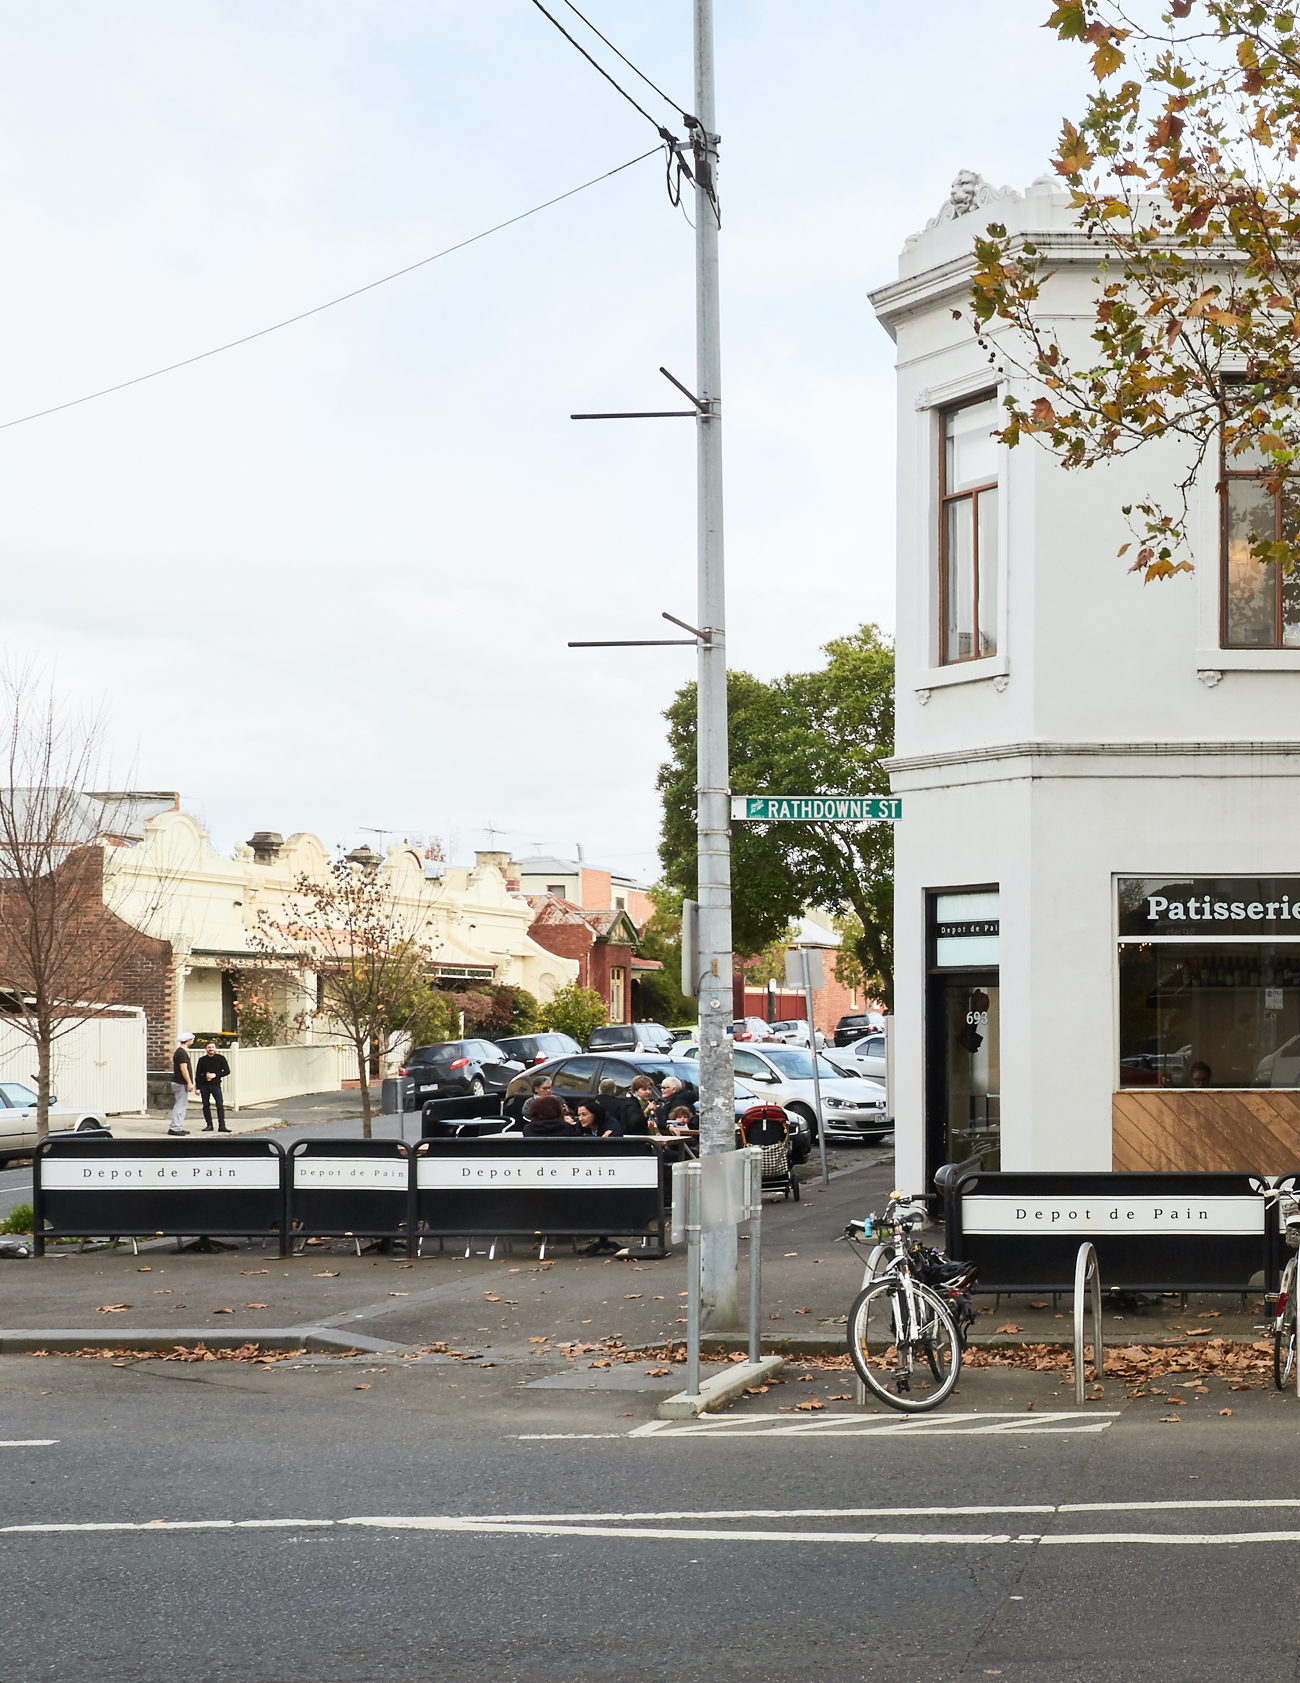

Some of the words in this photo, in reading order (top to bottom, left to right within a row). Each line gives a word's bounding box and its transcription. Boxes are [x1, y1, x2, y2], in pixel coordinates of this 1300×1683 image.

[767, 800, 873, 819] RATHDOWNE
[878, 800, 899, 819] ST
[941, 926, 967, 935] Depot
[970, 924, 981, 933] de
[984, 923, 999, 932] Pai
[966, 1011, 988, 1025] 693
[83, 1167, 144, 1180] Depot
[157, 1167, 178, 1178] de
[192, 1167, 237, 1178] Pain
[300, 1169, 342, 1178] Depot
[350, 1169, 365, 1177] de
[374, 1169, 405, 1178] Pain
[461, 1168, 523, 1179] Depot
[536, 1167, 558, 1177] de
[572, 1167, 617, 1177] Pain
[1016, 1208, 1092, 1223] Depot
[1109, 1208, 1135, 1220] de
[1154, 1207, 1208, 1220] Pain
